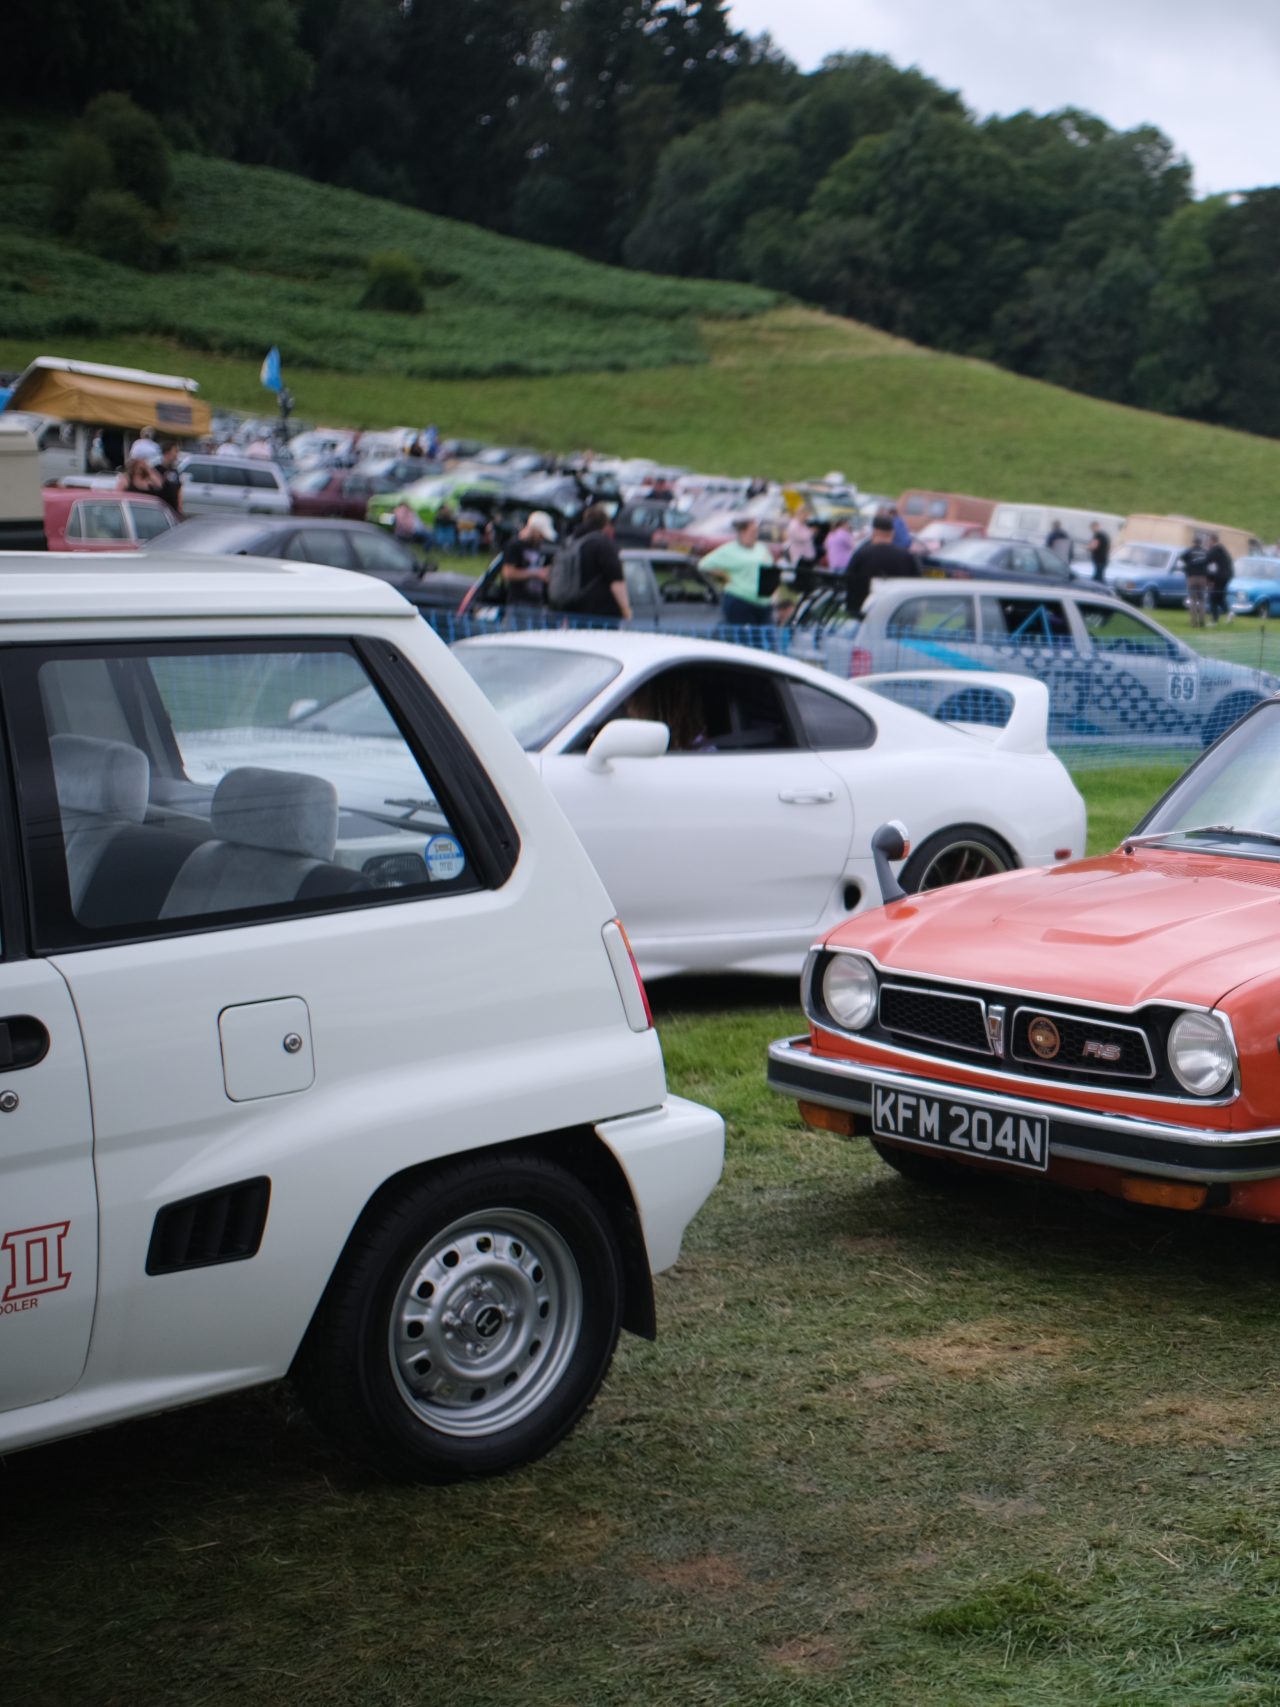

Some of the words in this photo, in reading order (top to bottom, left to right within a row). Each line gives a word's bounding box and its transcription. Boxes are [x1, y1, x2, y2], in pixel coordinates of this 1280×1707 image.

[1170, 676, 1195, 700] 69
[1082, 1040, 1121, 1061] RS
[876, 1088, 940, 1142] KFM
[948, 1105, 1042, 1163] 204N
